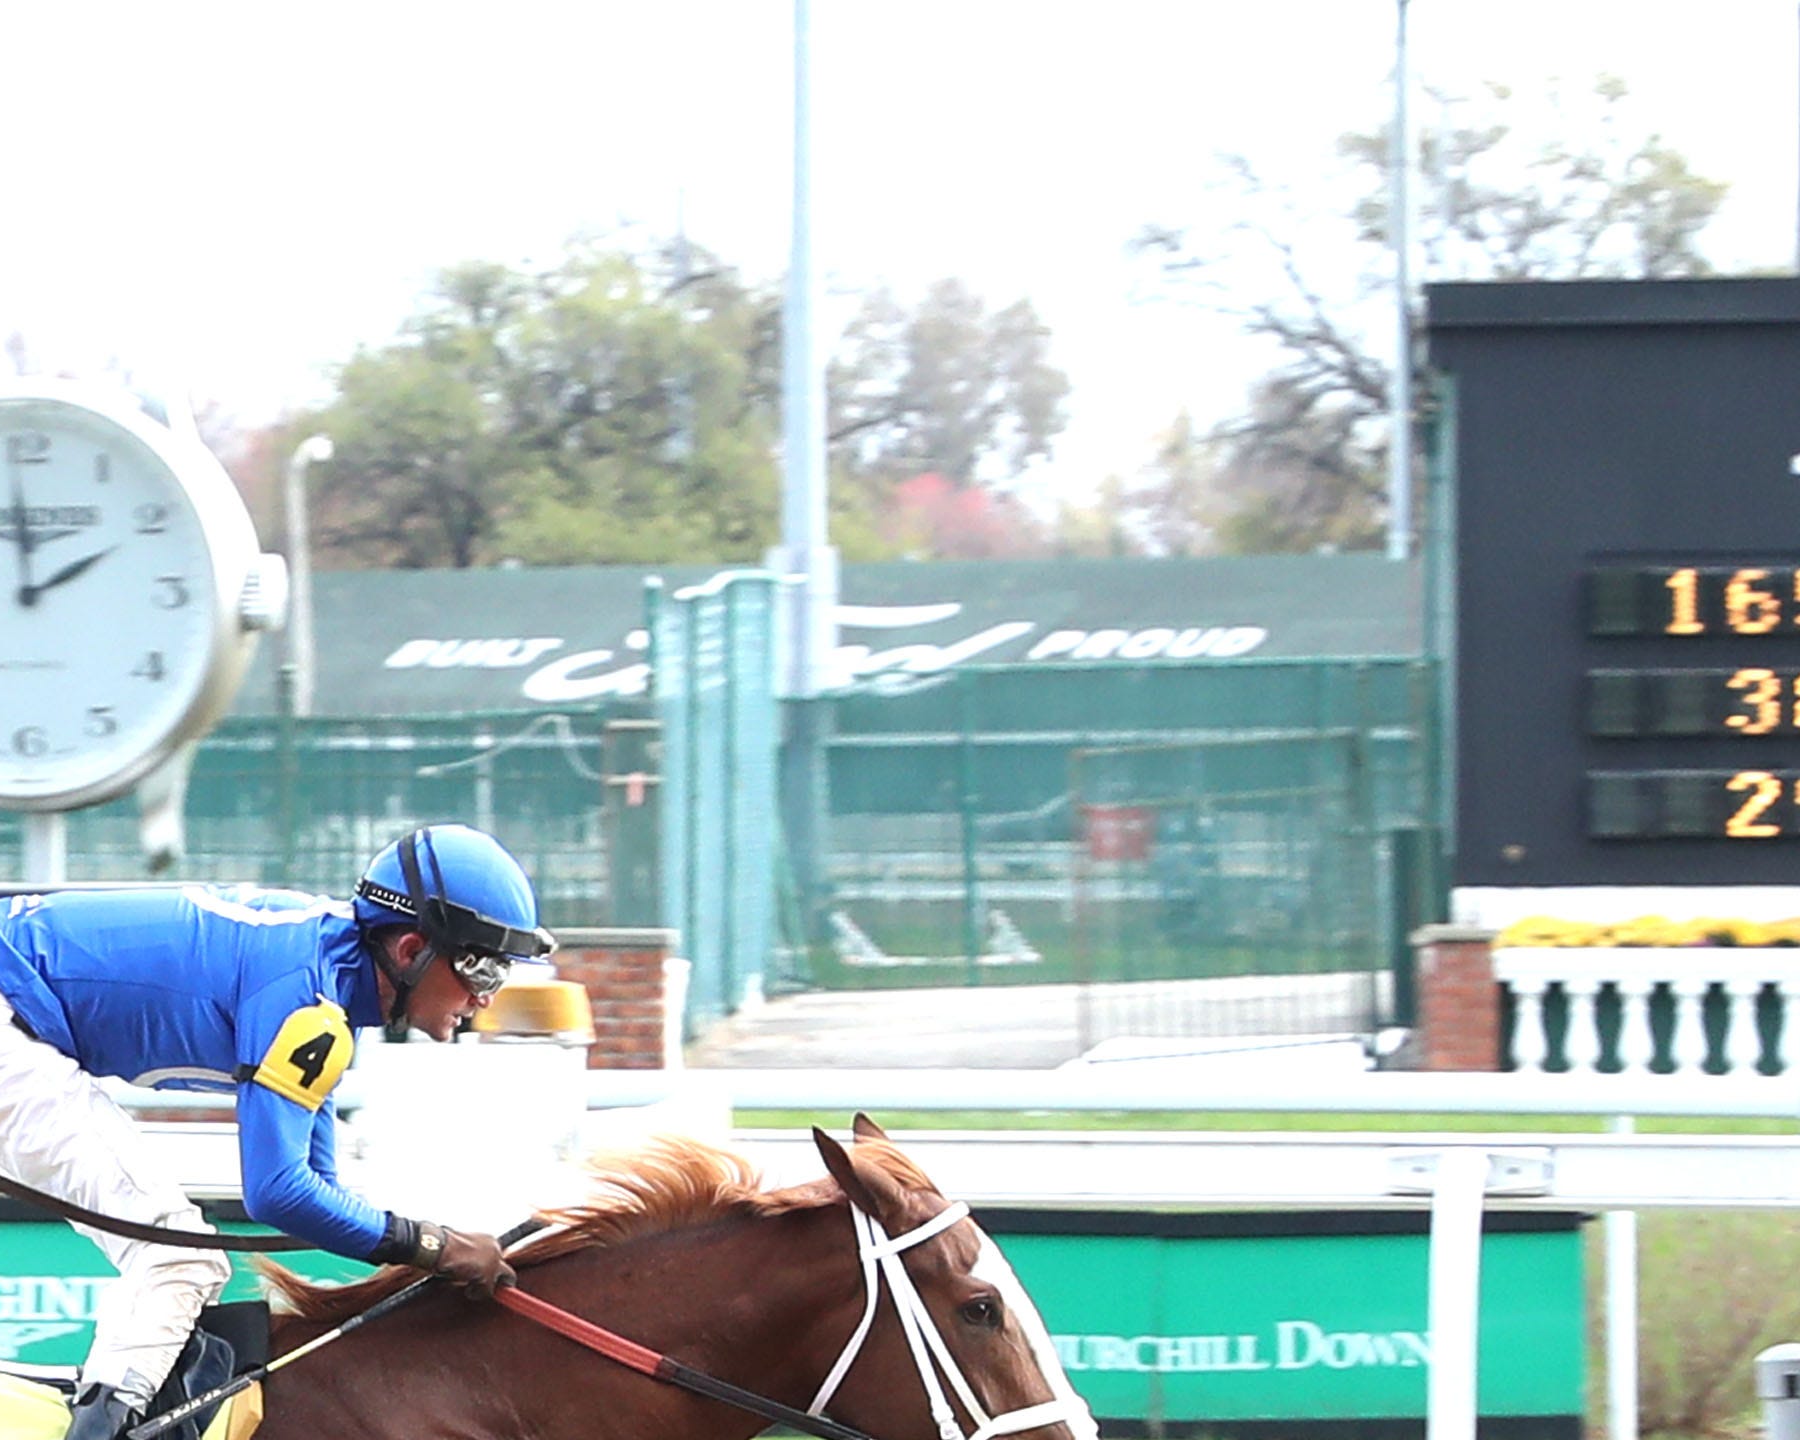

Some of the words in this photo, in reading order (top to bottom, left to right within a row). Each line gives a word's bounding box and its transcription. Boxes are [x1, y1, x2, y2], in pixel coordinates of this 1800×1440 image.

[133, 504, 170, 534] 2
[150, 576, 190, 610] 3
[1665, 567, 1800, 635] 16
[1027, 627, 1267, 660] PROUD
[129, 651, 166, 682] 4
[1725, 668, 1800, 735] 3
[82, 705, 118, 738] 5
[11, 725, 48, 757] 6
[1725, 770, 1800, 838] 2
[288, 1032, 337, 1089] 4
[1050, 1334, 1271, 1371] URCHILL
[1275, 1321, 1435, 1369] DOWN
